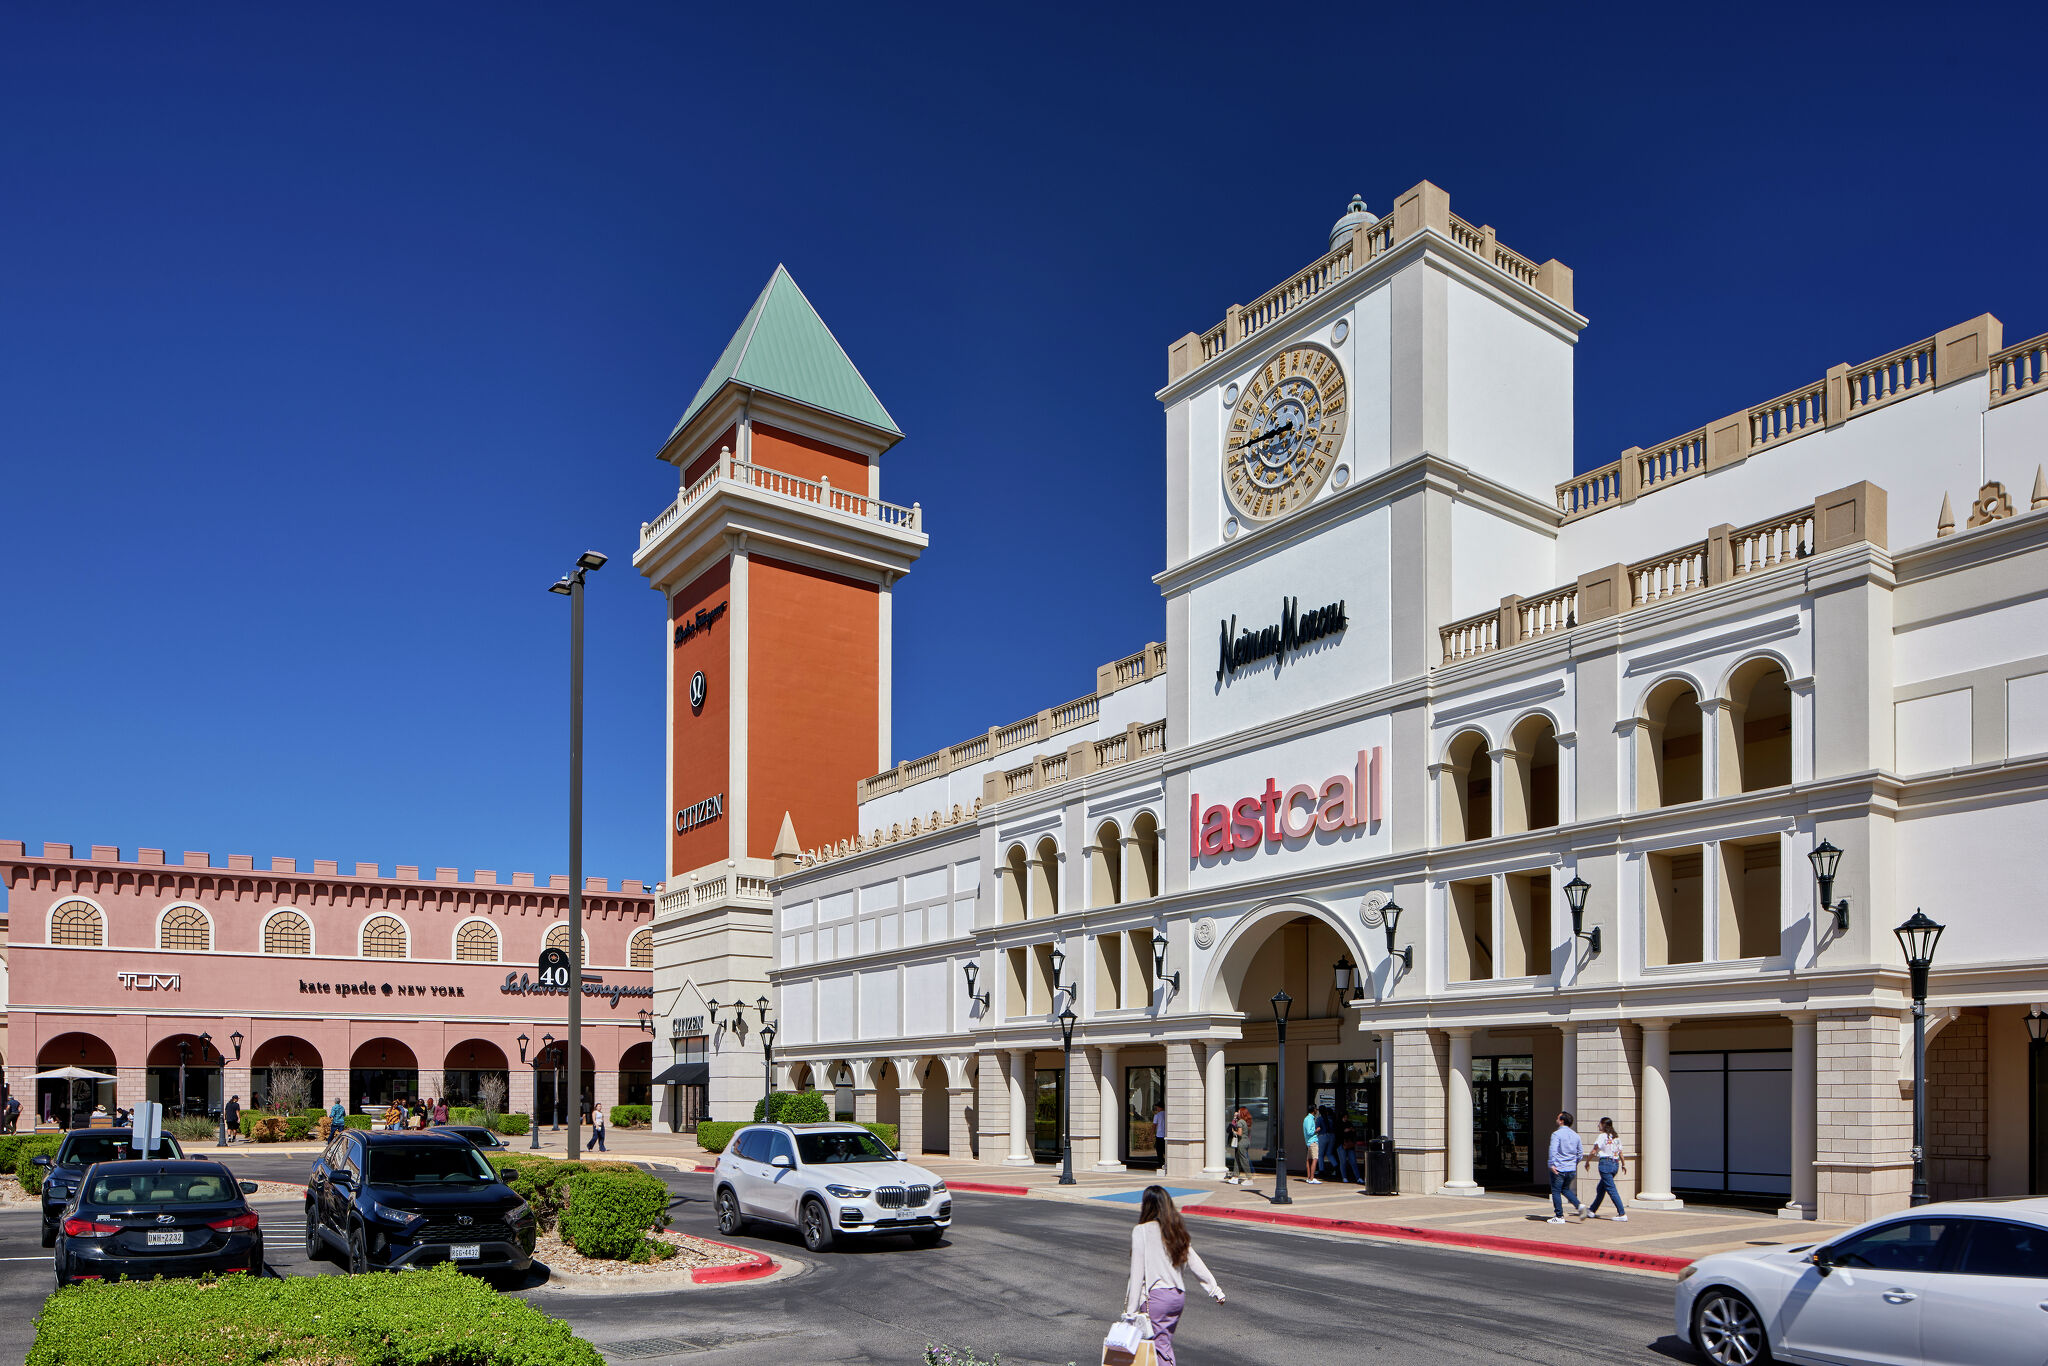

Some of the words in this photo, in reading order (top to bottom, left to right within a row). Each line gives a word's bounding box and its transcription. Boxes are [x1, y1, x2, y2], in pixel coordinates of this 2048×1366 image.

[676, 793, 724, 832] CITIZEN
[117, 971, 180, 989] TUMI
[540, 967, 569, 987] 40
[299, 979, 331, 994] kate
[335, 981, 376, 998] spade
[398, 985, 426, 996] NEW
[430, 985, 465, 997] YORK
[581, 974, 653, 1007] erragamo
[673, 1016, 704, 1033] CITIZEN
